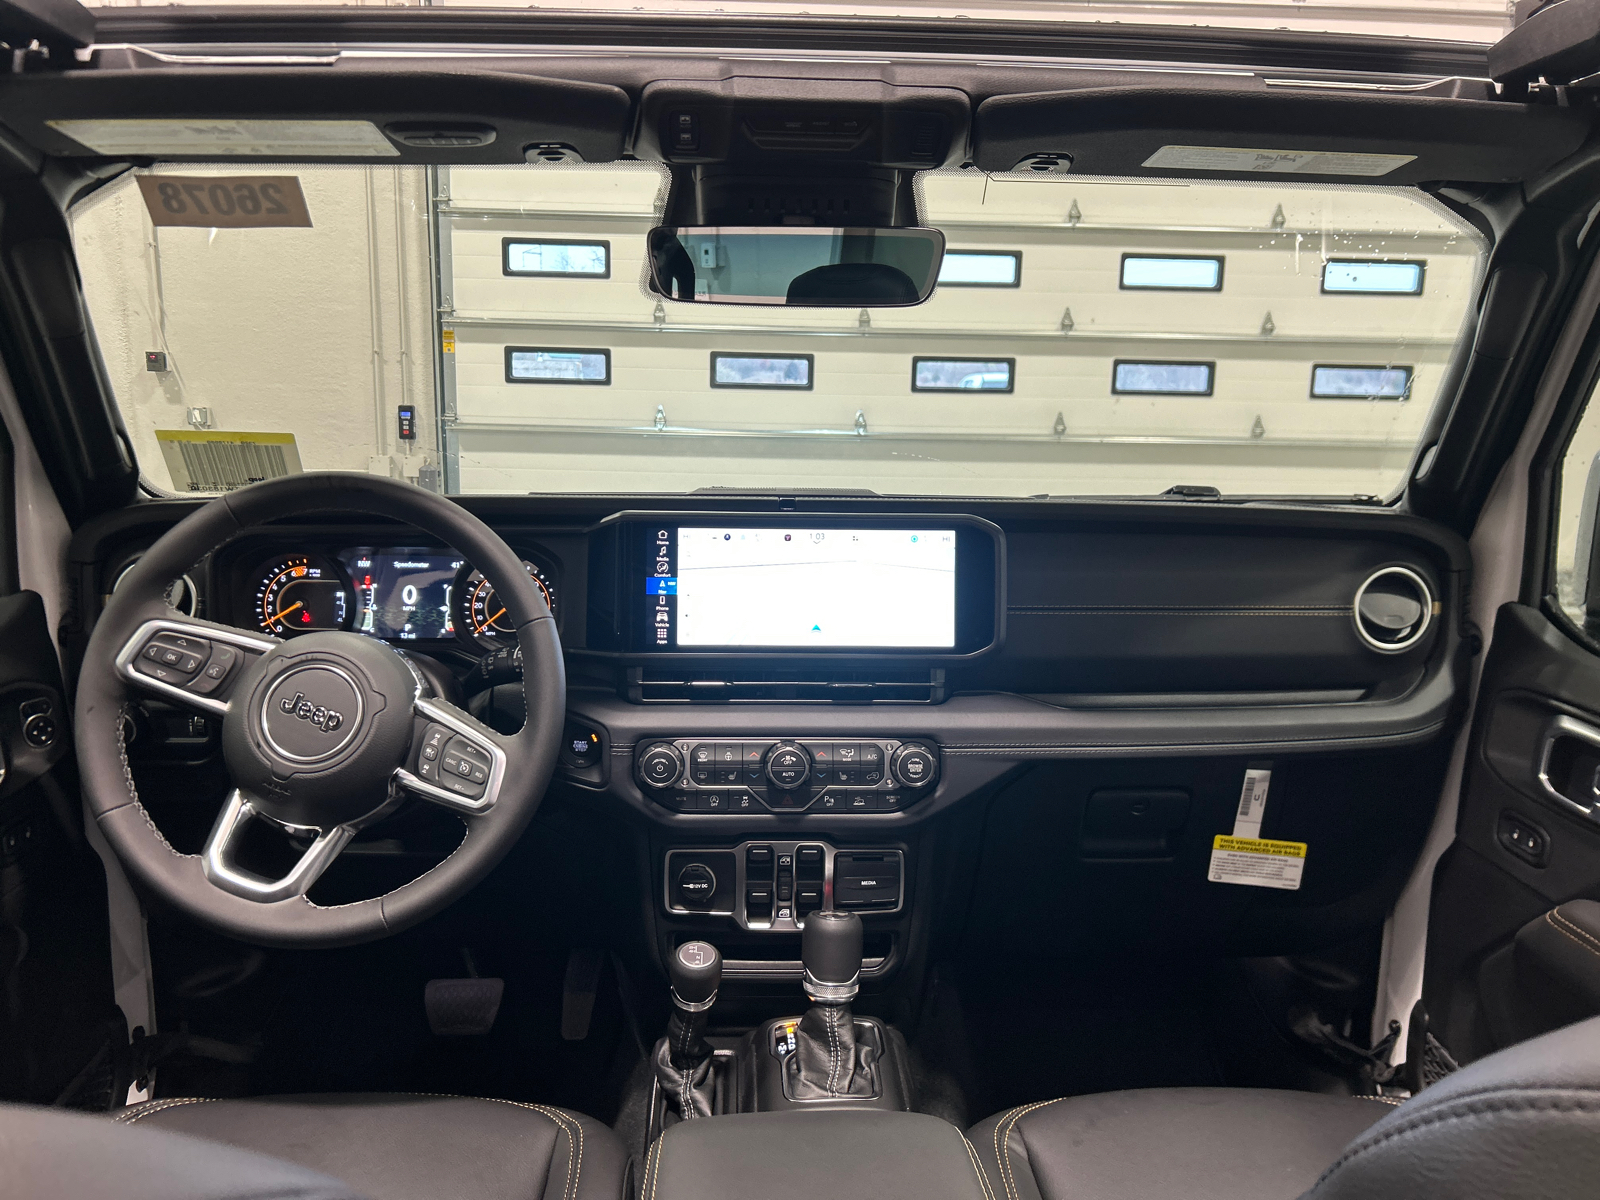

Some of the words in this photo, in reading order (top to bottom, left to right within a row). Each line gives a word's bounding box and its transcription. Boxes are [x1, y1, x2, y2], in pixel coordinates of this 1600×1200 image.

[393, 561, 430, 569] Speedometer
[402, 585, 417, 605] 0
[404, 623, 412, 632] P
[280, 690, 344, 733] Jeep
[445, 757, 457, 766] CANC
[1235, 839, 1262, 847] VEHICLE
[1270, 842, 1302, 851] EQUIPPED
[1236, 845, 1271, 854] ADVANCED
